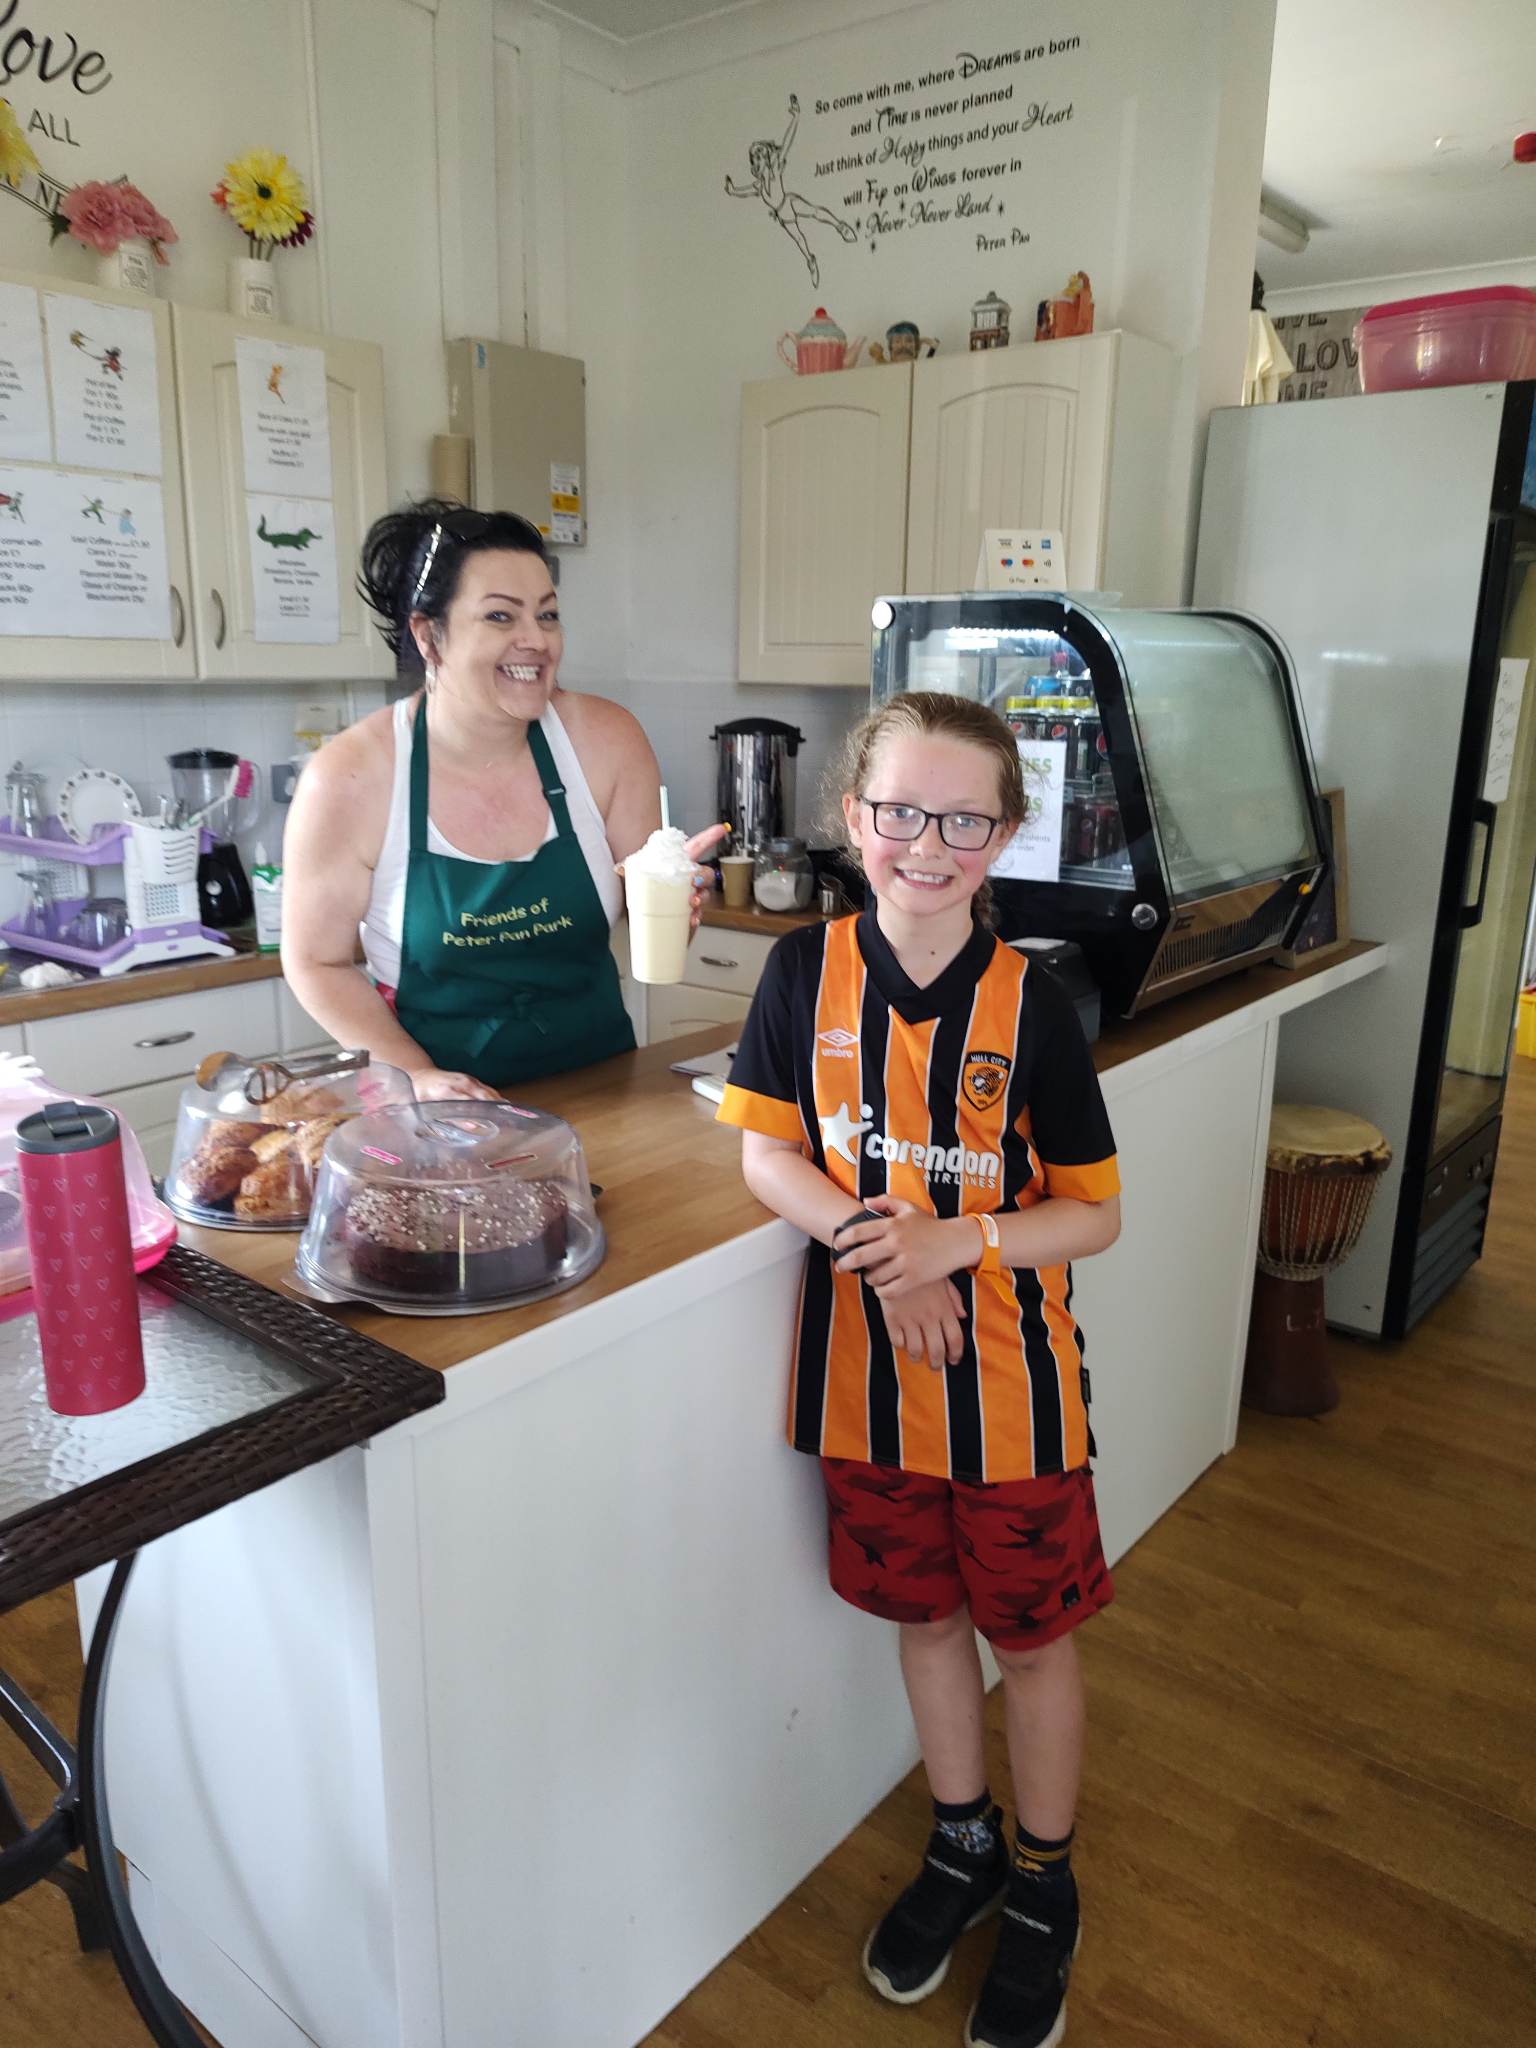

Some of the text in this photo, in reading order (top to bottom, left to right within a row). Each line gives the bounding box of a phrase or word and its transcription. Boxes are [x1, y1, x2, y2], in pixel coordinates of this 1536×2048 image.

[815, 99, 830, 114] So
[833, 92, 863, 111] come
[866, 82, 890, 101] with
[893, 80, 915, 95] me,
[918, 68, 955, 88] where
[1024, 45, 1045, 62] are
[1049, 35, 1080, 55] born
[27, 108, 80, 147] ALL
[850, 118, 872, 137] and
[911, 110, 921, 122] is
[924, 99, 959, 119] never
[962, 83, 1013, 114] planned
[814, 100, 1074, 178] Just think of Happy things and your Heart
[843, 189, 863, 207] will
[893, 183, 908, 197] on
[962, 162, 1007, 183] forever
[1010, 157, 1022, 173] in
[864, 209, 907, 239] Never
[908, 199, 952, 230] Never
[442, 915, 574, 947] Peter Pan Park
[461, 896, 550, 928] Friends of
[970, 1053, 1008, 1067] HULL CITY
[865, 1132, 1000, 1178] corendon
[922, 1170, 997, 1190] AIRLINES
